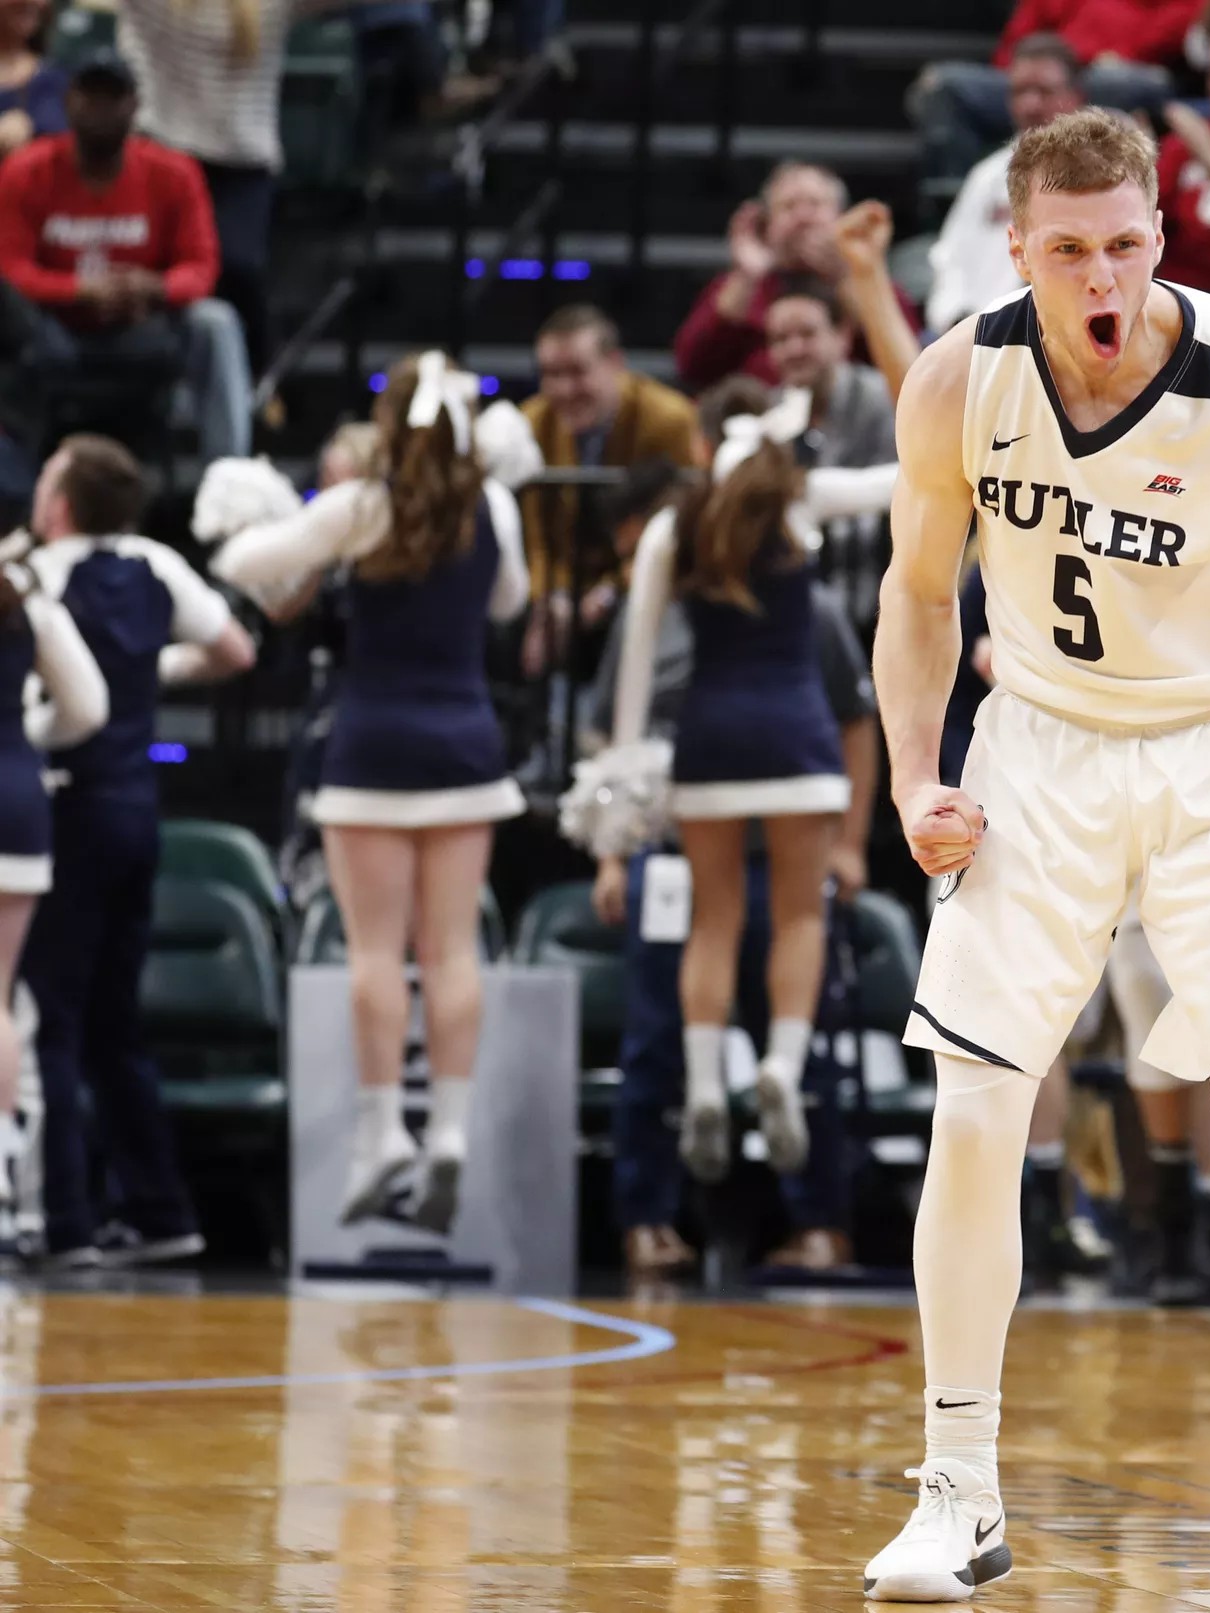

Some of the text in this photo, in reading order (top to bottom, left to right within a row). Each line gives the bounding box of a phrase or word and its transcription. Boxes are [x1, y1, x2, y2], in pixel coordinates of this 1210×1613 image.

[1146, 482, 1186, 495] EAST
[1153, 474, 1183, 486] BIG
[978, 476, 1186, 567] BUTLER
[1052, 553, 1105, 662] 5
